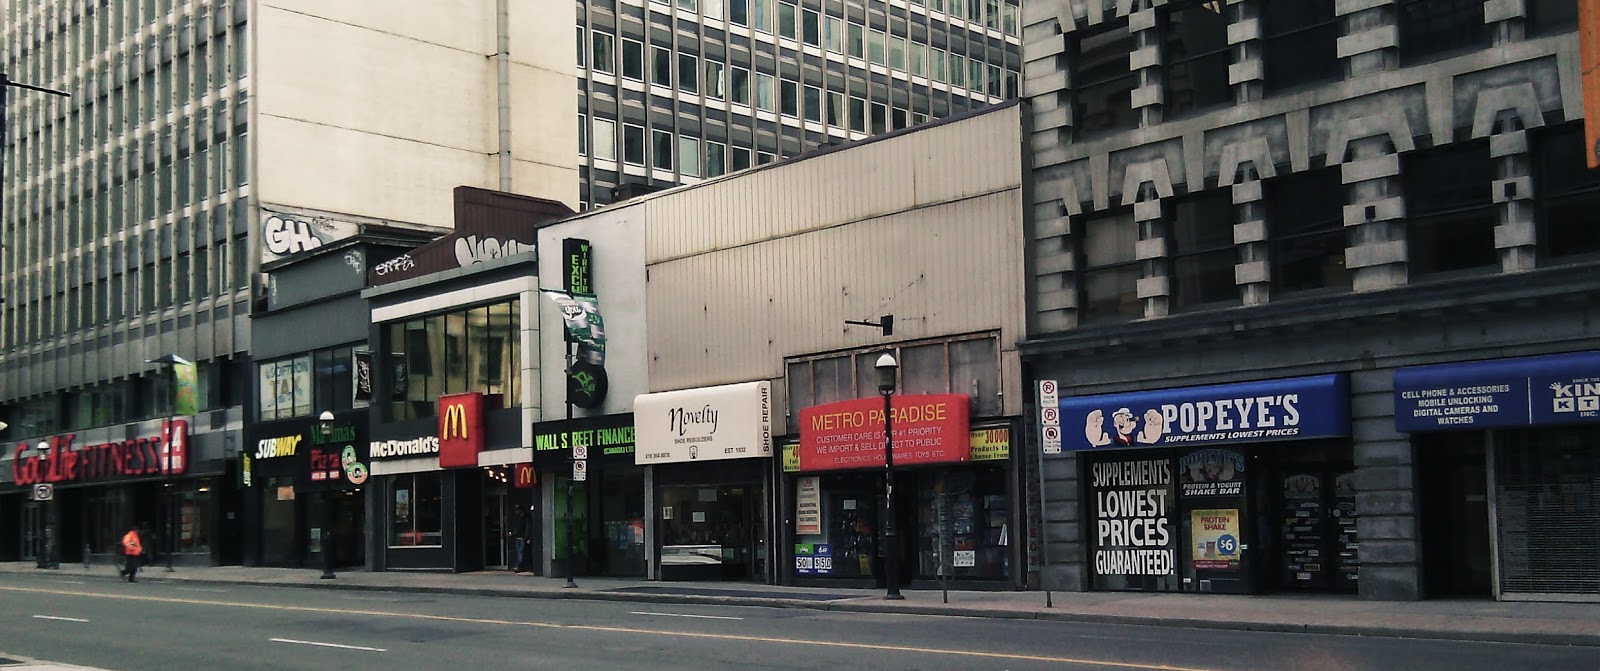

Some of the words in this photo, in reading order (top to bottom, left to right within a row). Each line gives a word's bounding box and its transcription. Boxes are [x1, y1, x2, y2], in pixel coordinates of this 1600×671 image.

[1402, 391, 1420, 399] CELL
[1421, 389, 1447, 398] PHONE
[1449, 388, 1455, 396] &
[1457, 384, 1510, 395] ACCESSORIES
[1418, 398, 1446, 407] MOBILE
[1448, 395, 1493, 406] UNLOCKING
[761, 387, 769, 422] REPAIR
[1161, 394, 1300, 434] POPEYE'S
[1413, 408, 1443, 417] DIGITAL
[1444, 405, 1480, 415] CAMERAS
[1482, 404, 1499, 413] AND
[668, 404, 718, 436] Novelty
[812, 411, 864, 431] METRO
[868, 403, 946, 426] PARADISE
[1437, 416, 1474, 425] WATCHES
[536, 434, 559, 451] WALL
[561, 430, 594, 448] SREET
[816, 433, 853, 444] CUSTOMER
[853, 432, 873, 441] CARE
[873, 431, 881, 440] IS
[881, 429, 898, 440] OR
[908, 426, 942, 436] PRIORITY
[1164, 432, 1226, 443] SUPPLEMENTS
[1227, 430, 1265, 439] LOWEST
[1266, 428, 1299, 437] PRICES
[255, 434, 302, 460] SUBWAY
[370, 436, 440, 458] McDonald's
[816, 446, 827, 455] WE
[828, 444, 852, 453] IMPORT
[854, 443, 859, 451] &
[860, 441, 877, 451] SELL
[878, 440, 904, 450] DIECT
[904, 439, 915, 447] TO
[916, 437, 942, 447] PUBLIC
[873, 452, 912, 461] HOUWARES
[13, 433, 78, 486] GoLife
[82, 436, 158, 479] FITNESS
[1093, 459, 1171, 487] SUPPLEMENTS
[1184, 488, 1217, 496] SHAKE
[1219, 487, 1241, 495] BAR
[1097, 489, 1167, 518] LOWEST
[1200, 516, 1230, 524] PROTEIN
[1098, 518, 1169, 547] PRICES
[1220, 539, 1233, 551] $6
[1095, 549, 1174, 575] GUARANTEED!
